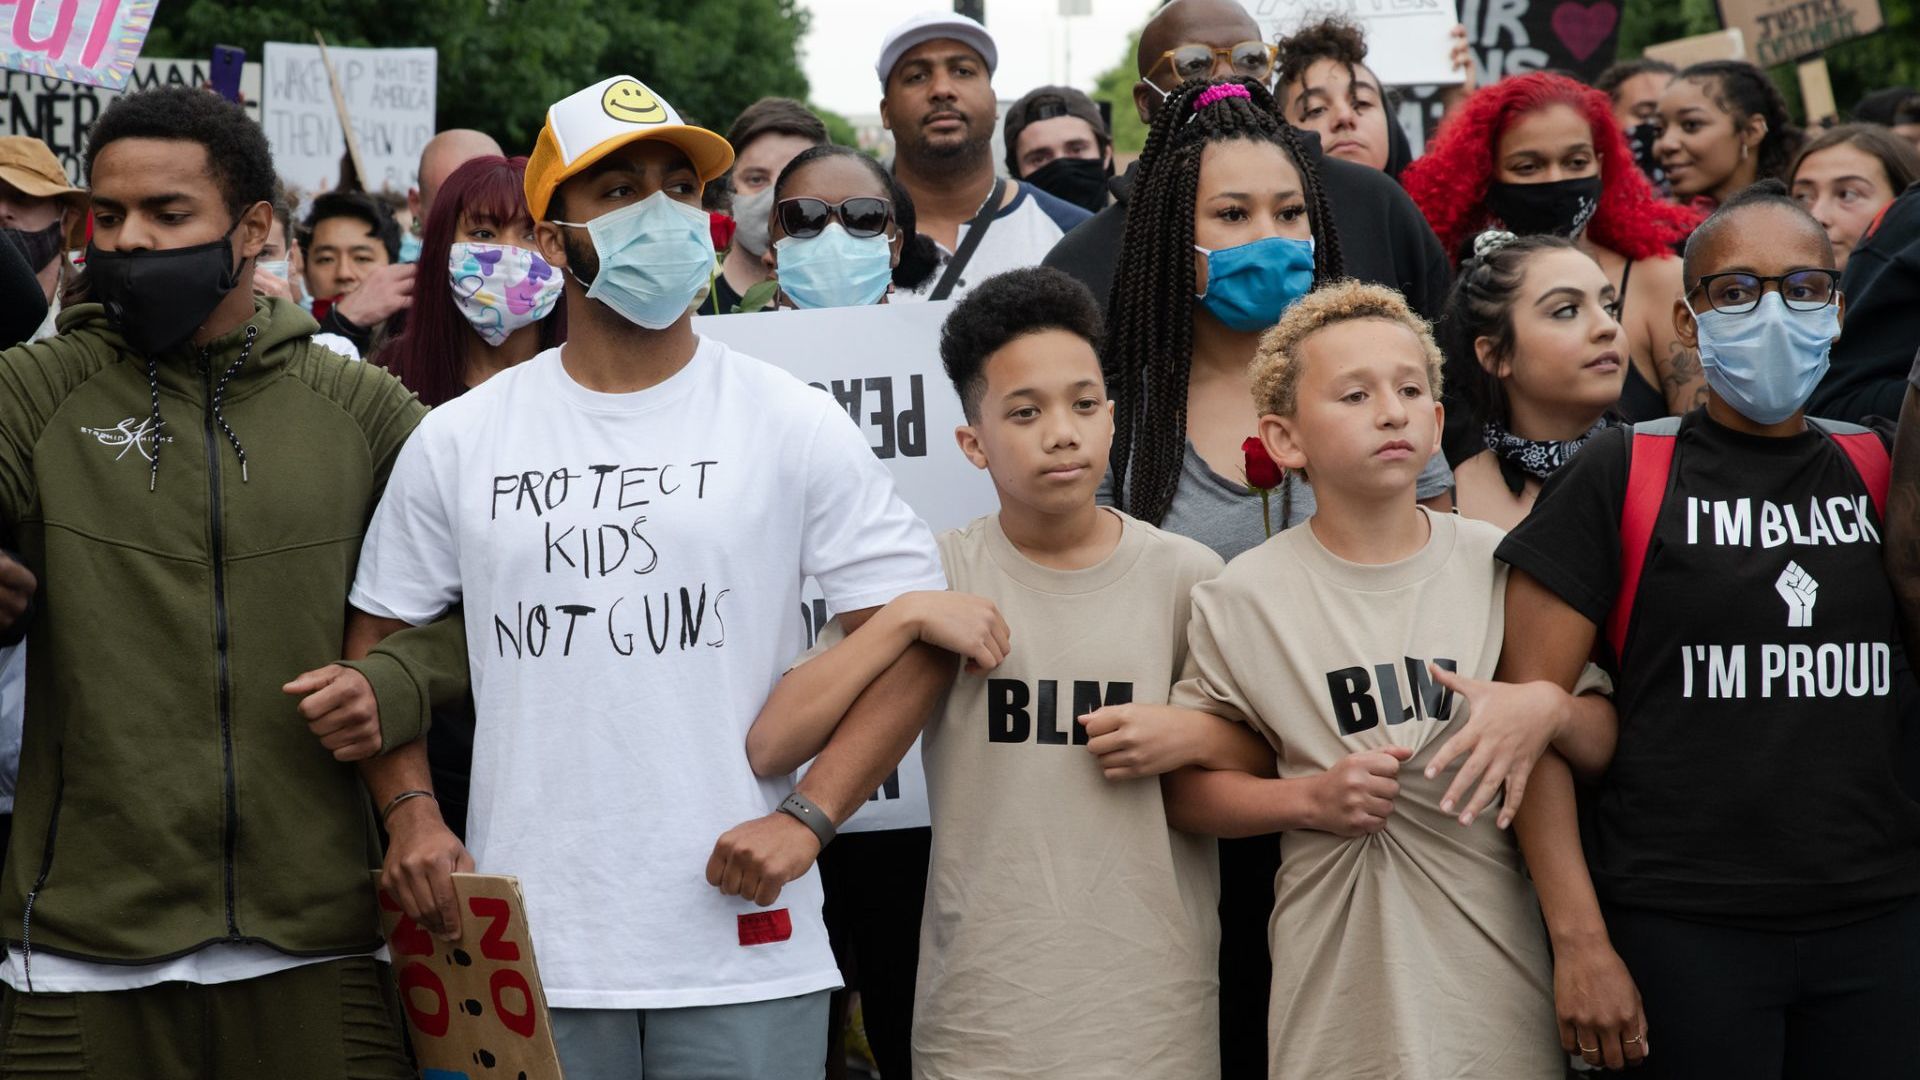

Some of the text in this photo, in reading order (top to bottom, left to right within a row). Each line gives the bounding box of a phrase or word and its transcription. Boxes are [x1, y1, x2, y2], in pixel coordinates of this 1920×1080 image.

[270, 56, 324, 104] WAKE
[271, 109, 333, 158] THEN
[808, 374, 927, 460] PEA
[491, 461, 719, 520] PROTECT
[1687, 493, 1881, 549] I'M BLACK
[545, 515, 658, 579] KIDS
[494, 601, 597, 660] NOT
[608, 582, 730, 656] GUNS
[1326, 656, 1457, 736] BLM
[1681, 642, 1890, 699] I'M PROUD
[987, 678, 1134, 745] BLM
